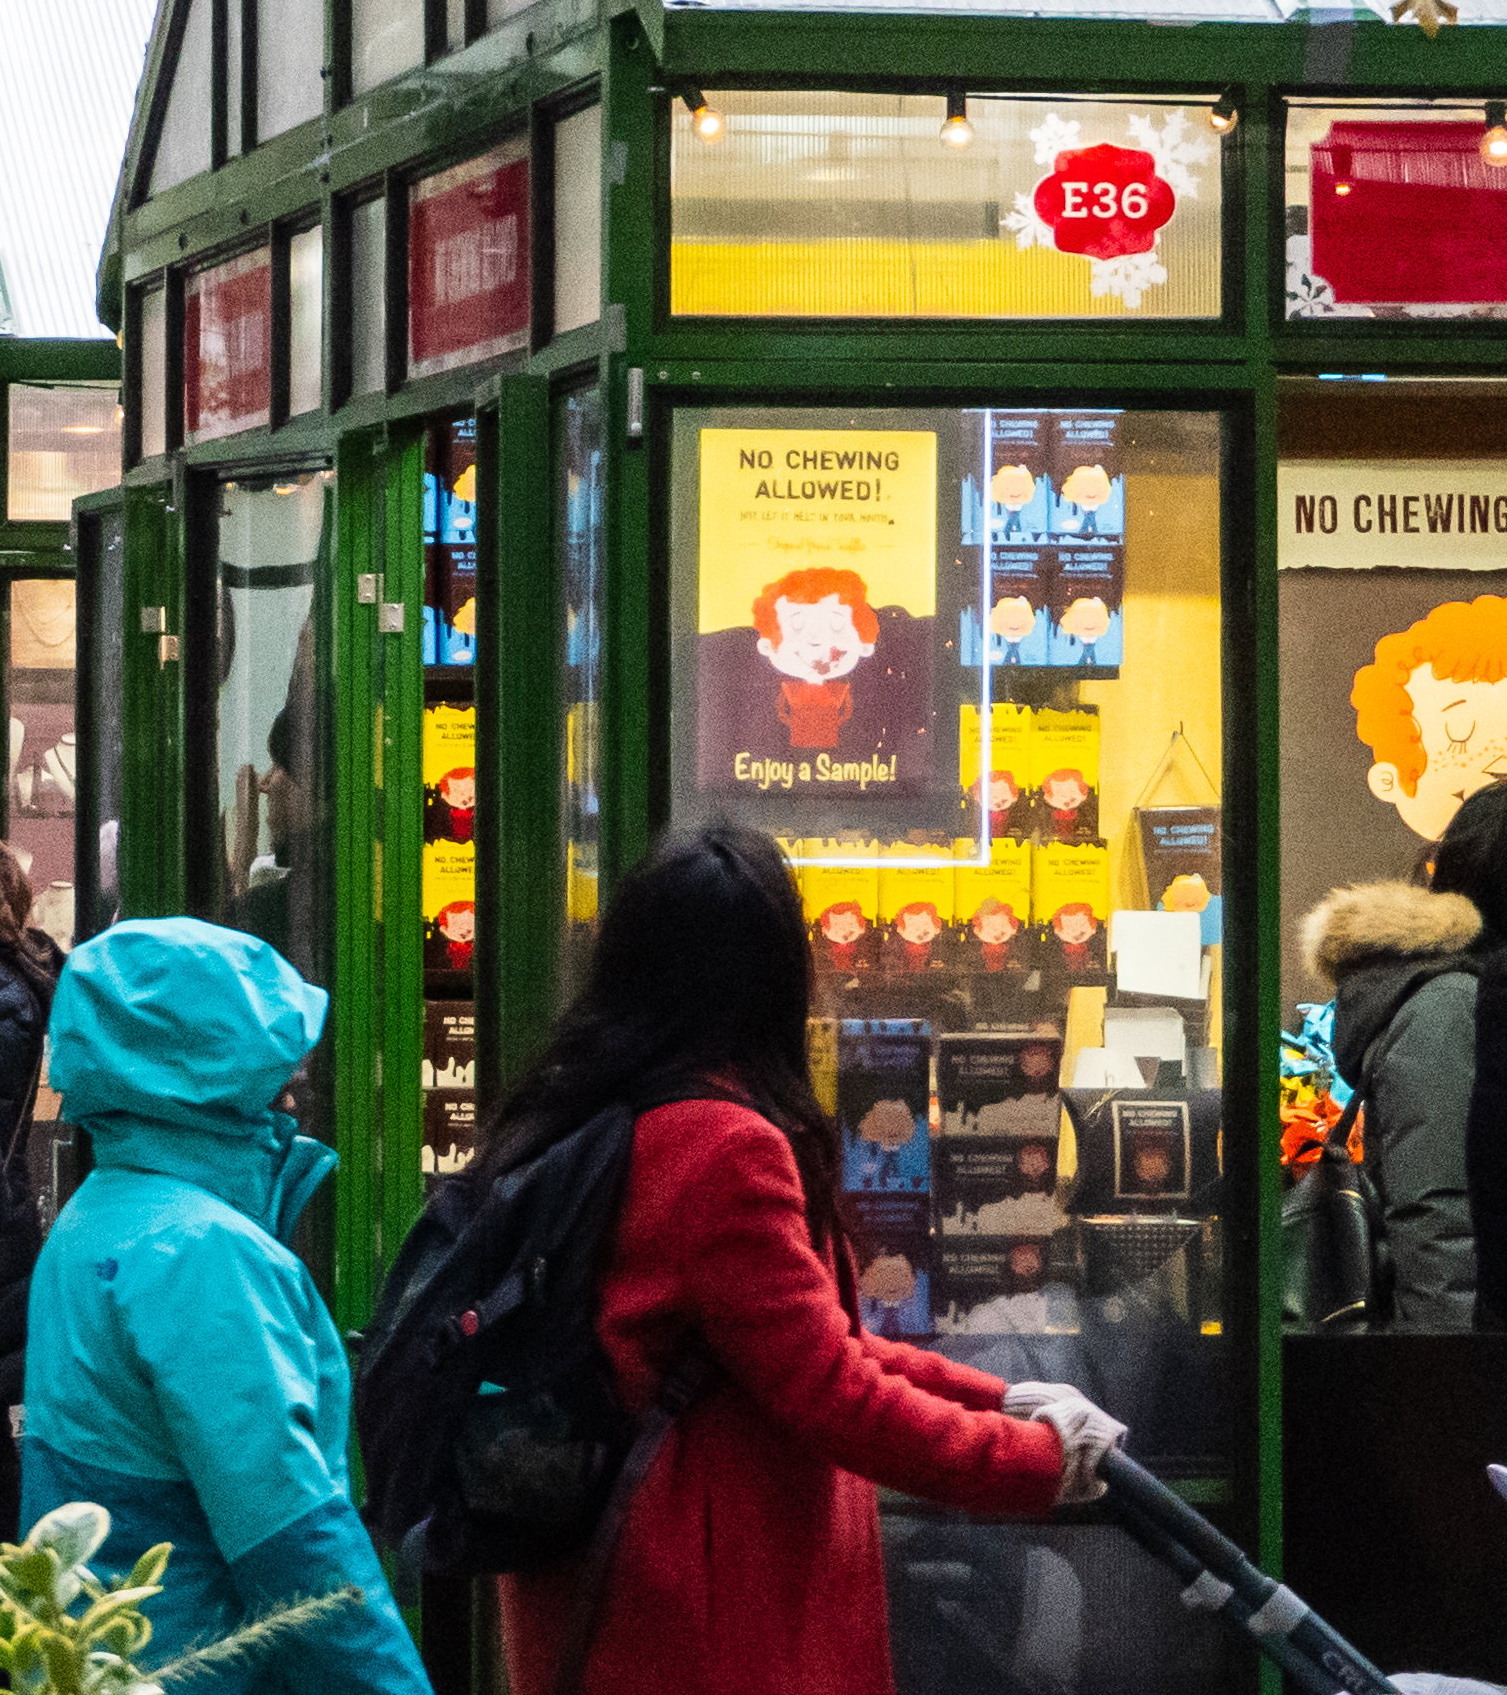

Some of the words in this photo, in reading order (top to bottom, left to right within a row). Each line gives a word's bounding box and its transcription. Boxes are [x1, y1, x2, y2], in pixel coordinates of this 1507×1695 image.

[1060, 181, 1149, 219] E36
[739, 449, 773, 470] NO
[785, 450, 900, 471] CHEWING
[754, 478, 882, 502] ALLOWED!
[1295, 494, 1339, 535] NO
[735, 752, 794, 790] Enjoy
[798, 762, 811, 781] a
[815, 752, 897, 791] Sample!
